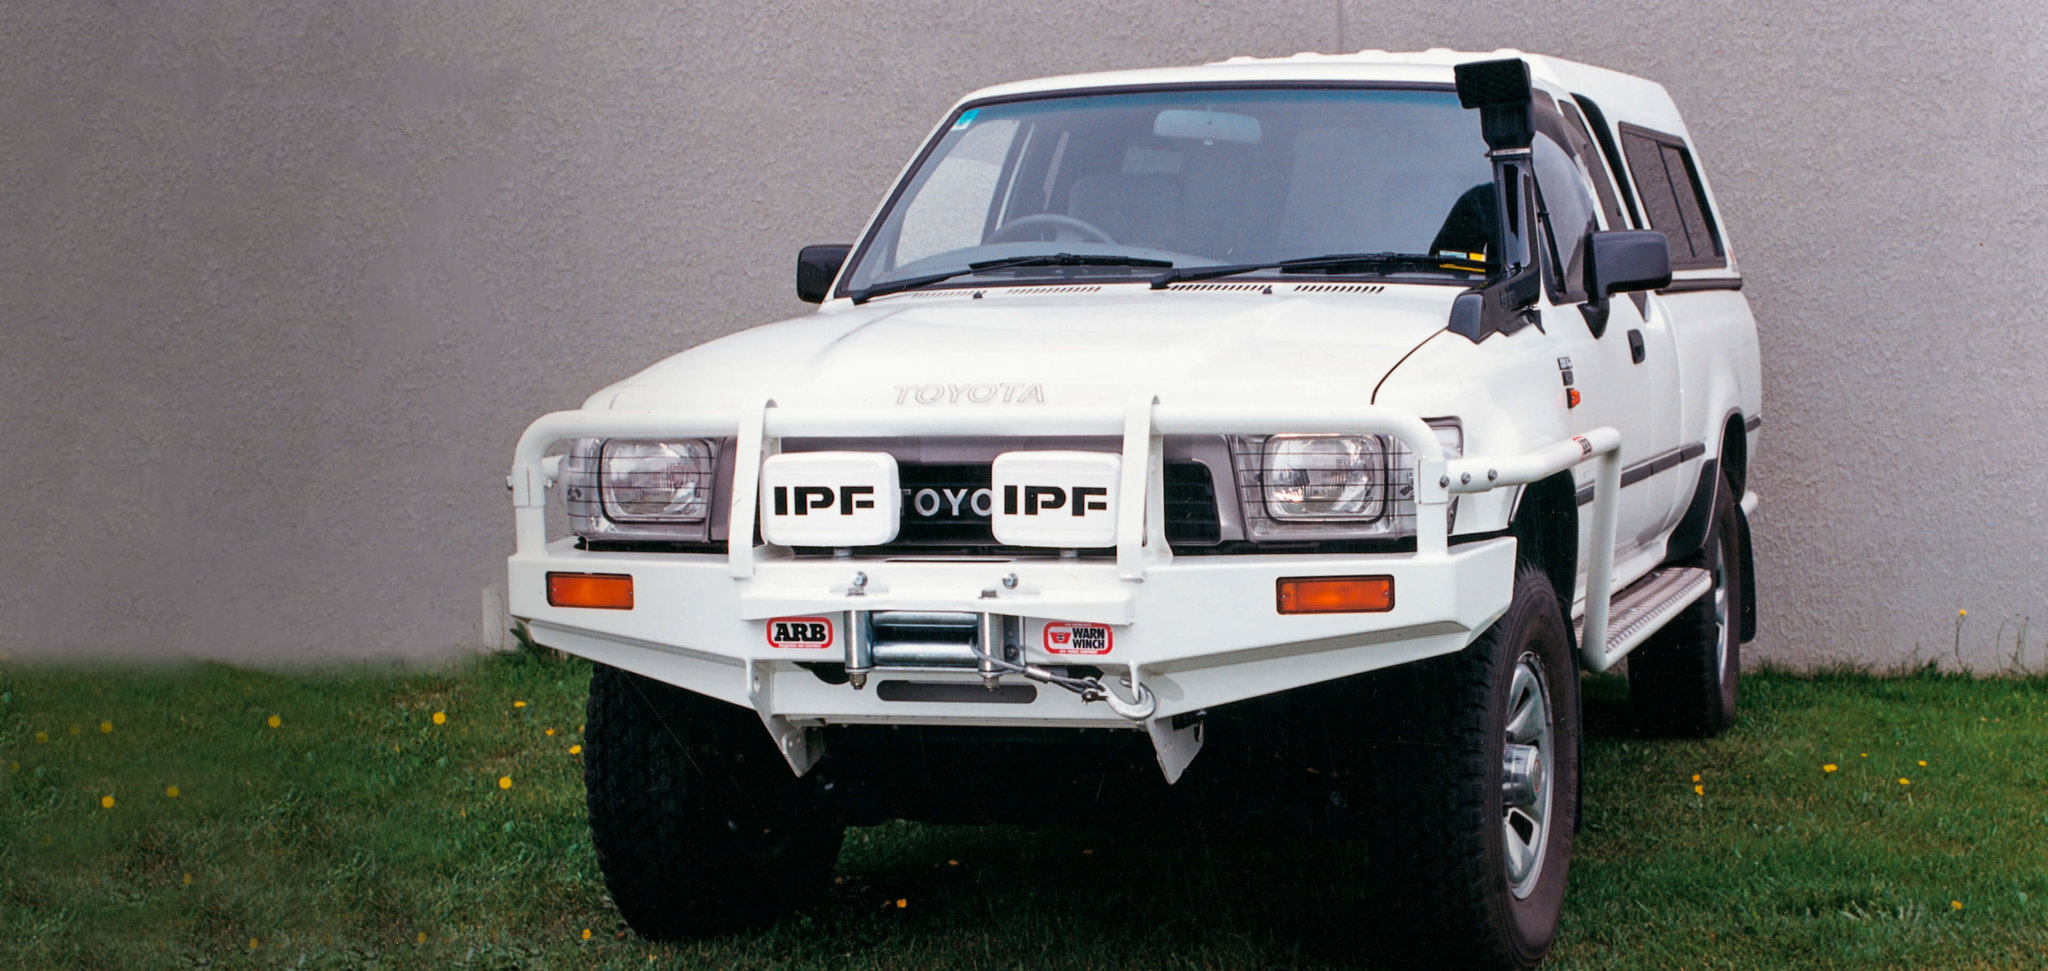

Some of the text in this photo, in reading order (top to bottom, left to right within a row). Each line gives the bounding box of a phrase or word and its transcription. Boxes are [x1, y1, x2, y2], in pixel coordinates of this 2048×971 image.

[894, 382, 1045, 405] TOYOTA
[774, 486, 874, 516] IPF
[1004, 485, 1107, 517] IPF
[774, 623, 827, 642] ARB
[1072, 627, 1105, 639] WARN
[1072, 639, 1105, 649] WINCH
